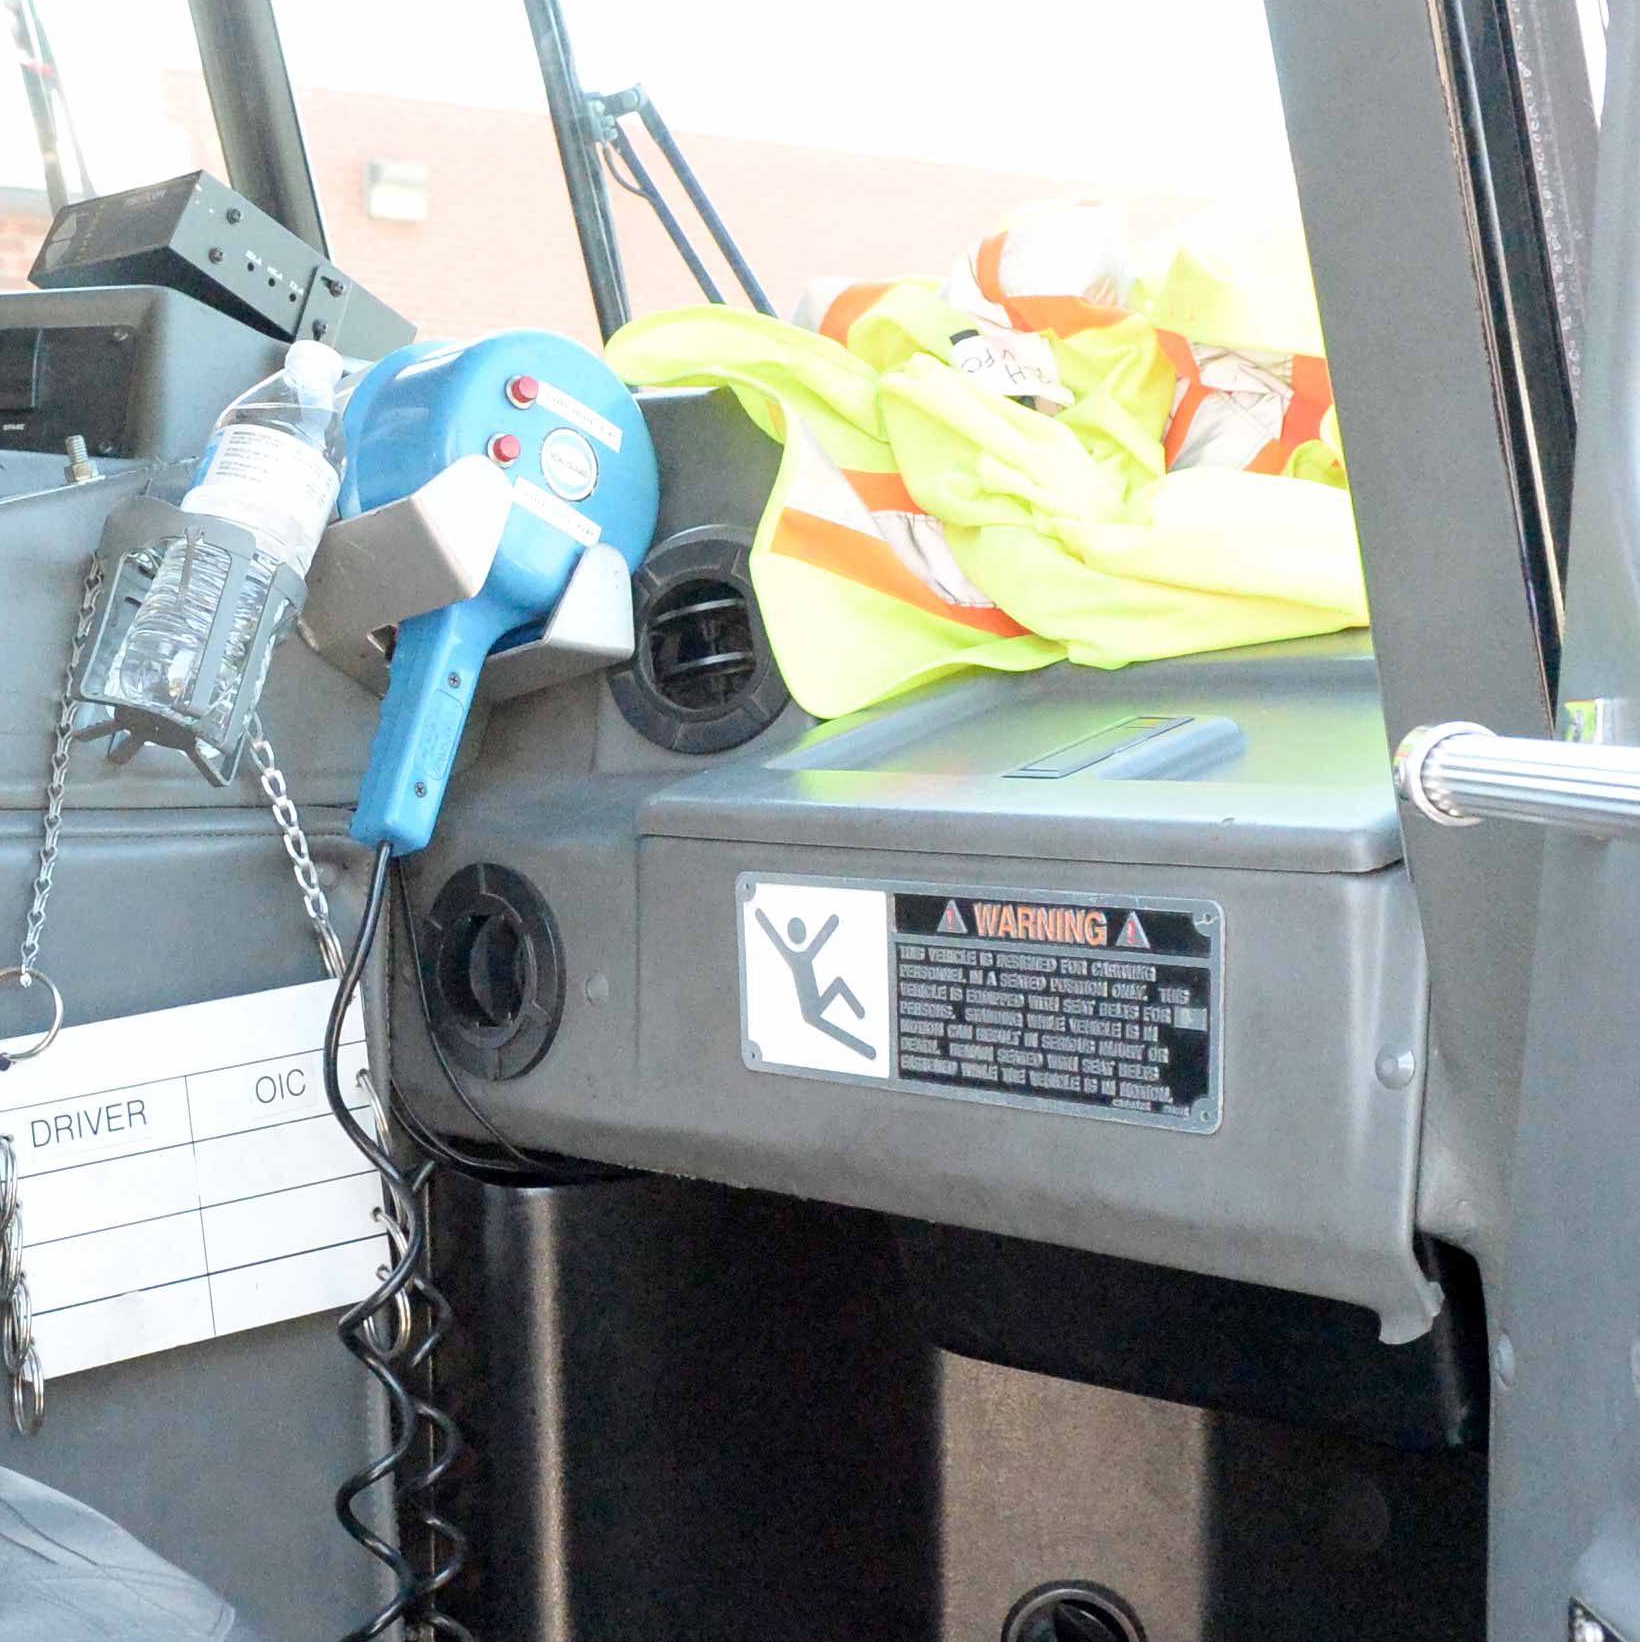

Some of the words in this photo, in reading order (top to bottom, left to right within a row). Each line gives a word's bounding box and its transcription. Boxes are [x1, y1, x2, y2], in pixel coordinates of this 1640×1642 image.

[972, 901, 1107, 946] WARNING
[927, 947, 977, 965] VEHICLE
[980, 952, 993, 967] IS
[1061, 959, 1087, 975] FOR
[901, 982, 947, 1000] VEHICLE
[950, 987, 962, 1001] IS
[1027, 995, 1060, 1012] WITH
[1063, 998, 1096, 1015] SEAT
[1143, 1006, 1171, 1024] FOR
[969, 969, 983, 985] IN
[987, 970, 997, 986] A
[999, 973, 1046, 991] SEATED
[1050, 979, 1108, 997] POSITION
[1159, 987, 1191, 1005] THIS
[1126, 1023, 1140, 1040] IS
[1143, 1026, 1159, 1042] IN
[1148, 1046, 1169, 1064] OR
[1084, 1077, 1098, 1094] IS
[30, 1099, 148, 1148] DRIVER
[255, 1068, 306, 1104] OIC
